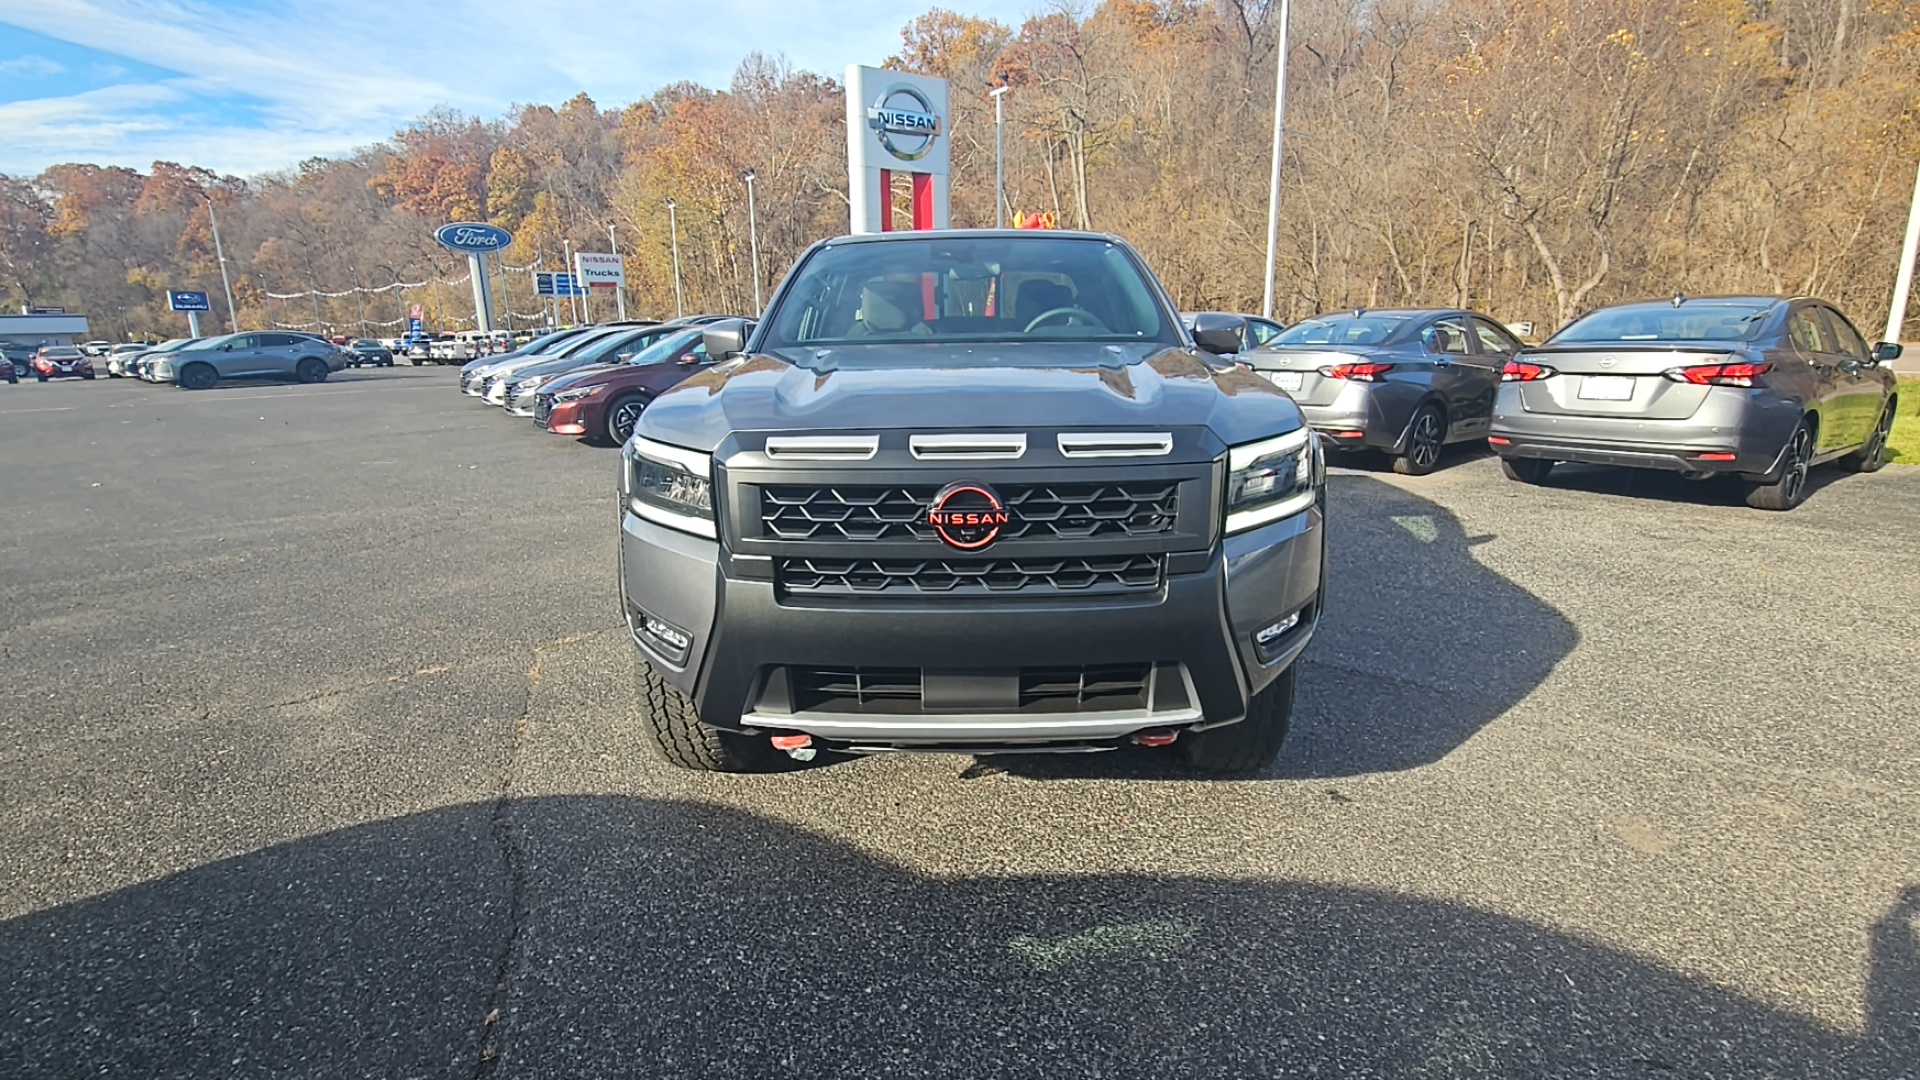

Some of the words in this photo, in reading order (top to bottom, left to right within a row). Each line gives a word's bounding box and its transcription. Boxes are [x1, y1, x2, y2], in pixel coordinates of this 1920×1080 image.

[877, 111, 936, 131] NISSAN
[454, 227, 498, 246] Ford
[582, 256, 619, 264] NISSAN
[584, 268, 620, 277] Trucks
[929, 512, 1009, 525] NISSAN
